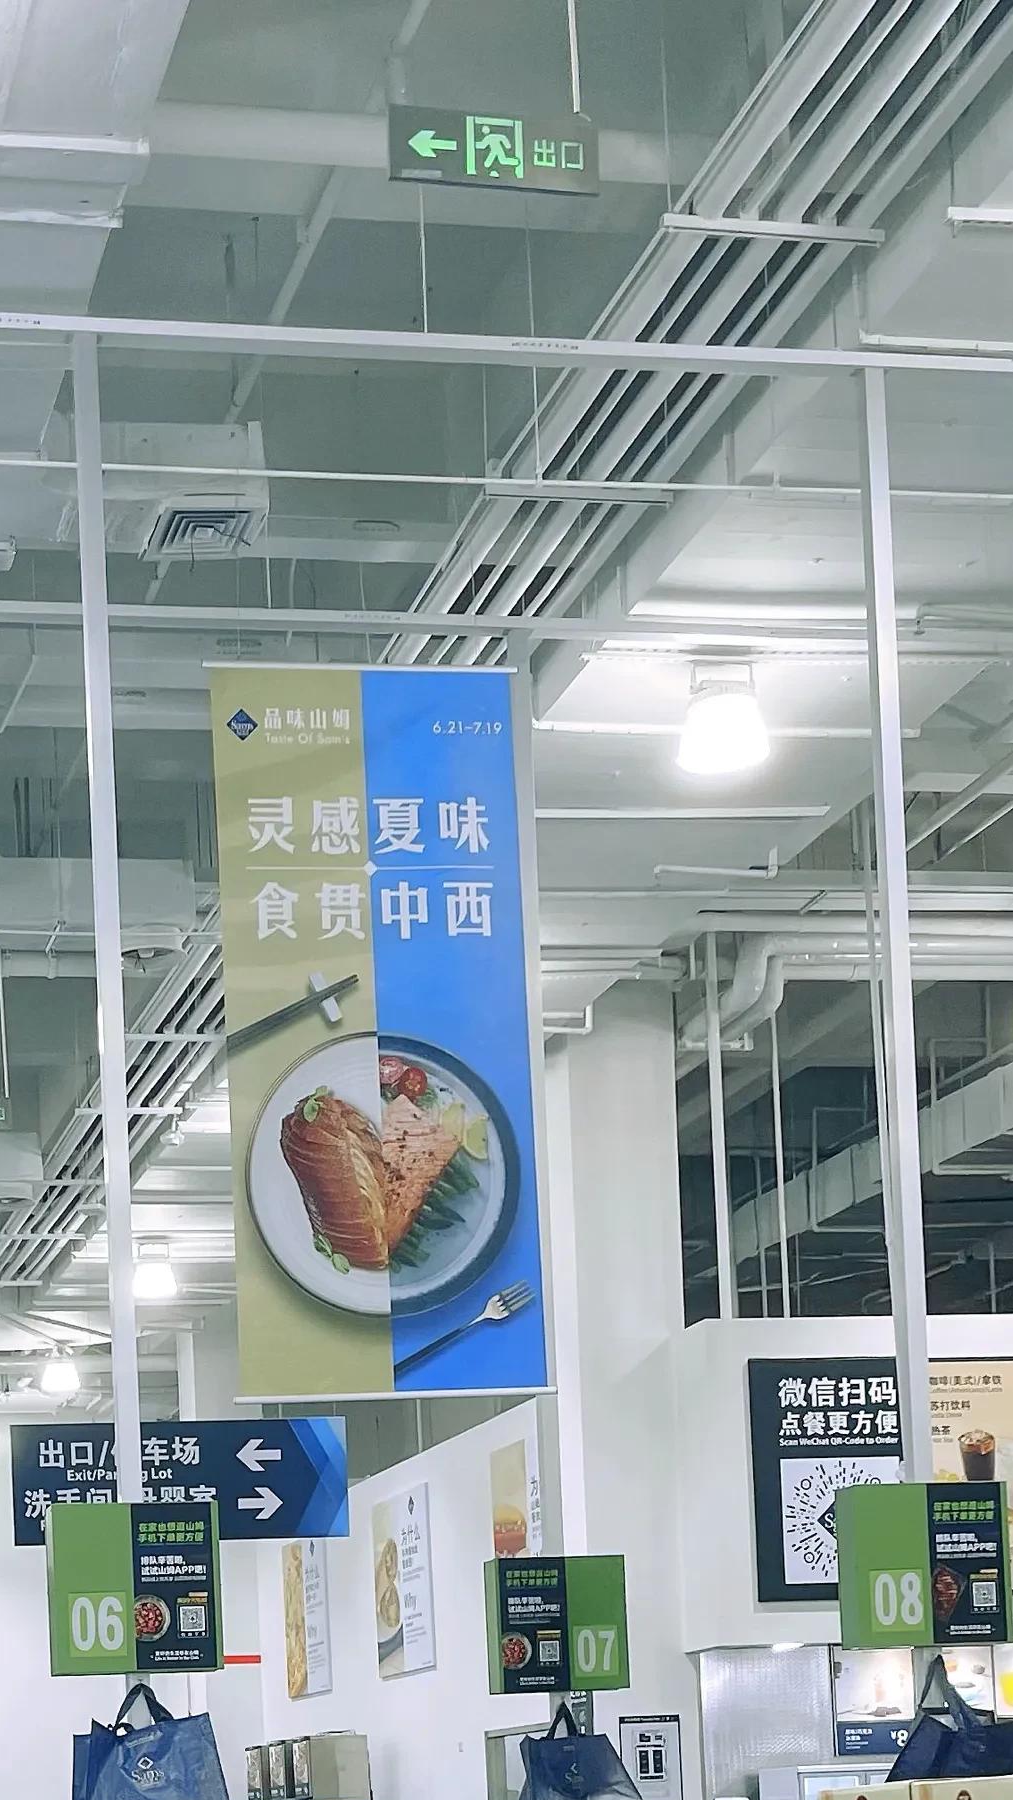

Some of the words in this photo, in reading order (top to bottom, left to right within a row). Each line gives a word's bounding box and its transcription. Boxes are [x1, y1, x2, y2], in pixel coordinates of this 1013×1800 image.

[533, 139, 584, 170] 出口
[264, 708, 350, 730] 品味山姆
[432, 720, 503, 735] 6.21-7.19
[247, 796, 490, 855] 灵感夏味
[250, 881, 493, 940] 食贯中西
[778, 1376, 897, 1408] 微信扫码
[779, 1410, 899, 1436] 点餐更方便
[39, 1437, 200, 1469] 出口/车场
[779, 1438, 798, 1446] Scan
[799, 1437, 829, 1446] WeChat
[67, 1468, 148, 1483] Exit/Parg
[151, 1468, 173, 1480] Lot
[875, 1572, 924, 1626] 08
[71, 1596, 124, 1651] 06
[577, 1629, 615, 1672] 07
